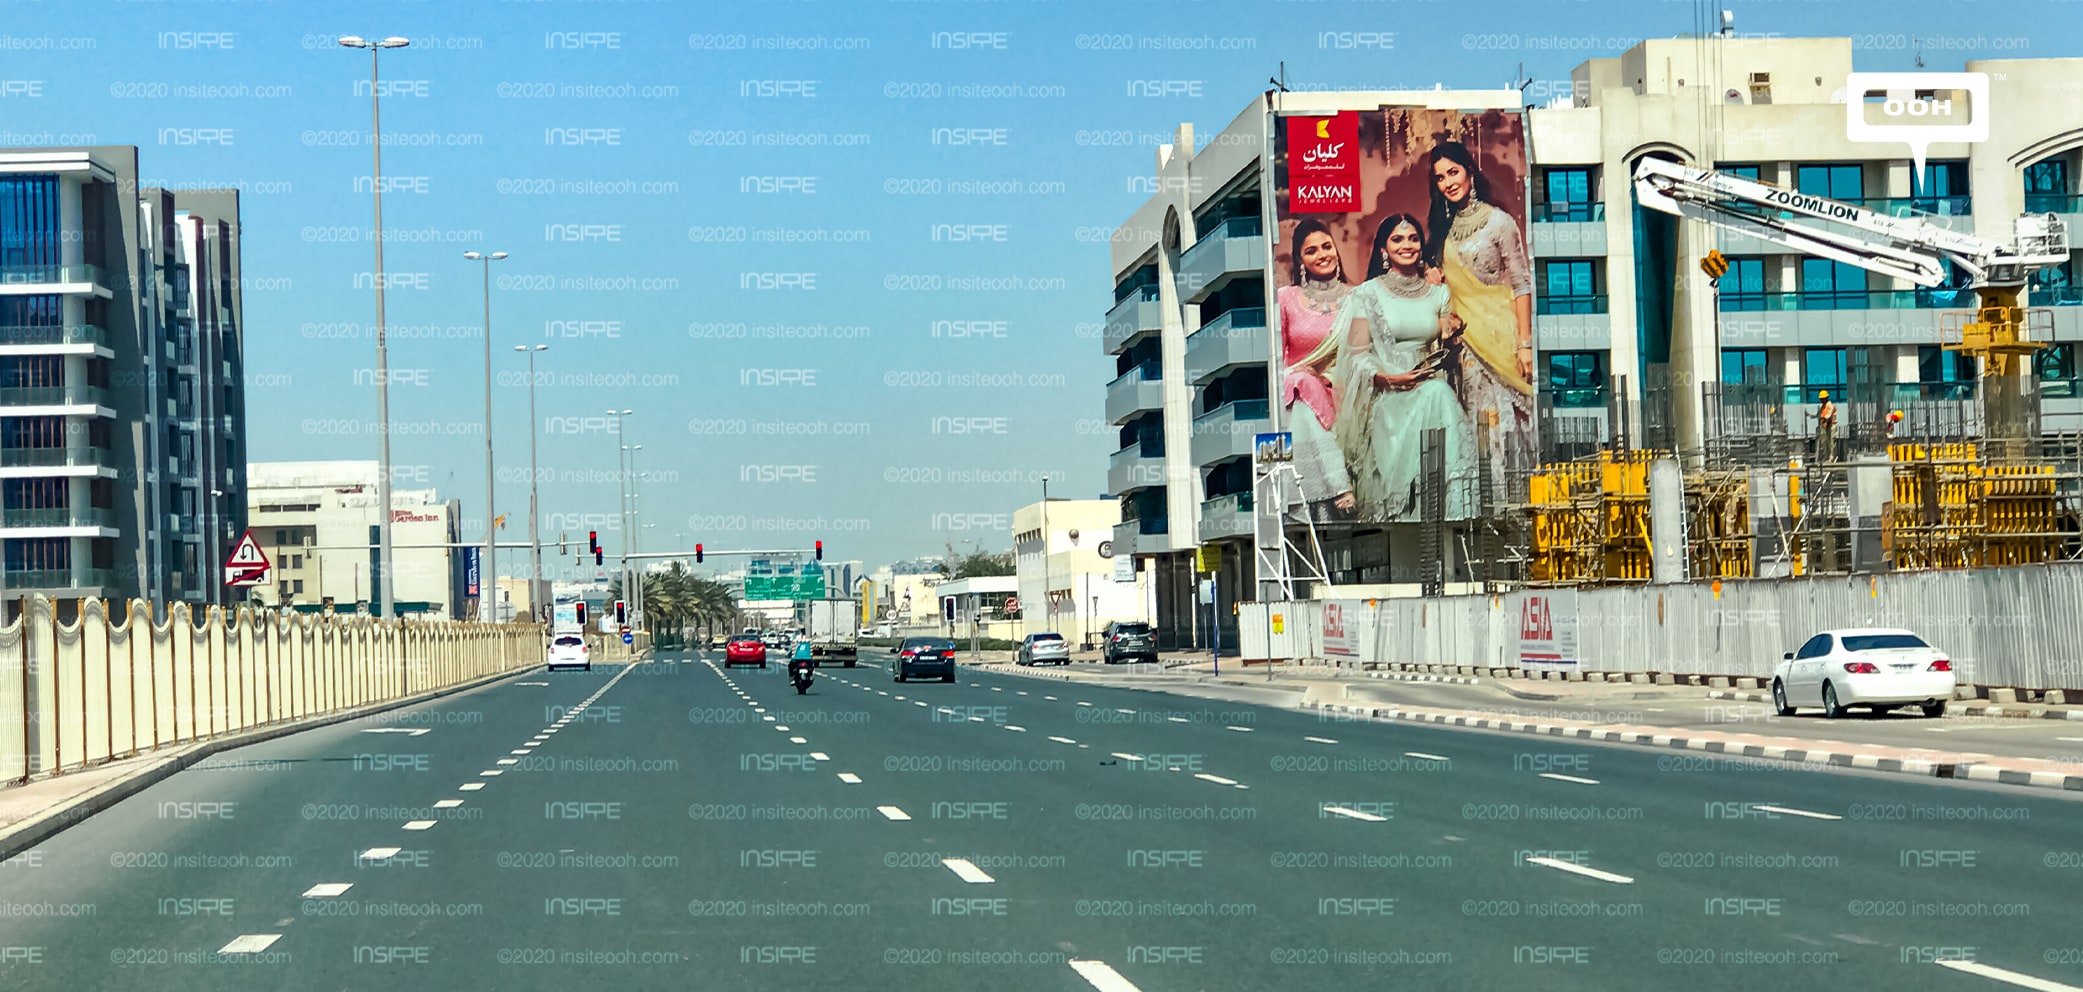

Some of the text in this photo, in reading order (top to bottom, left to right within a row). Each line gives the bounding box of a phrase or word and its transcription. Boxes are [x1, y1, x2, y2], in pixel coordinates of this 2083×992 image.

[1303, 142, 1345, 162] كليان
[1297, 184, 1353, 199] KALYAN
[1765, 188, 1859, 222] ZOOMLION
[1322, 603, 1345, 638] ASIA
[1520, 596, 1553, 641] ASIA
